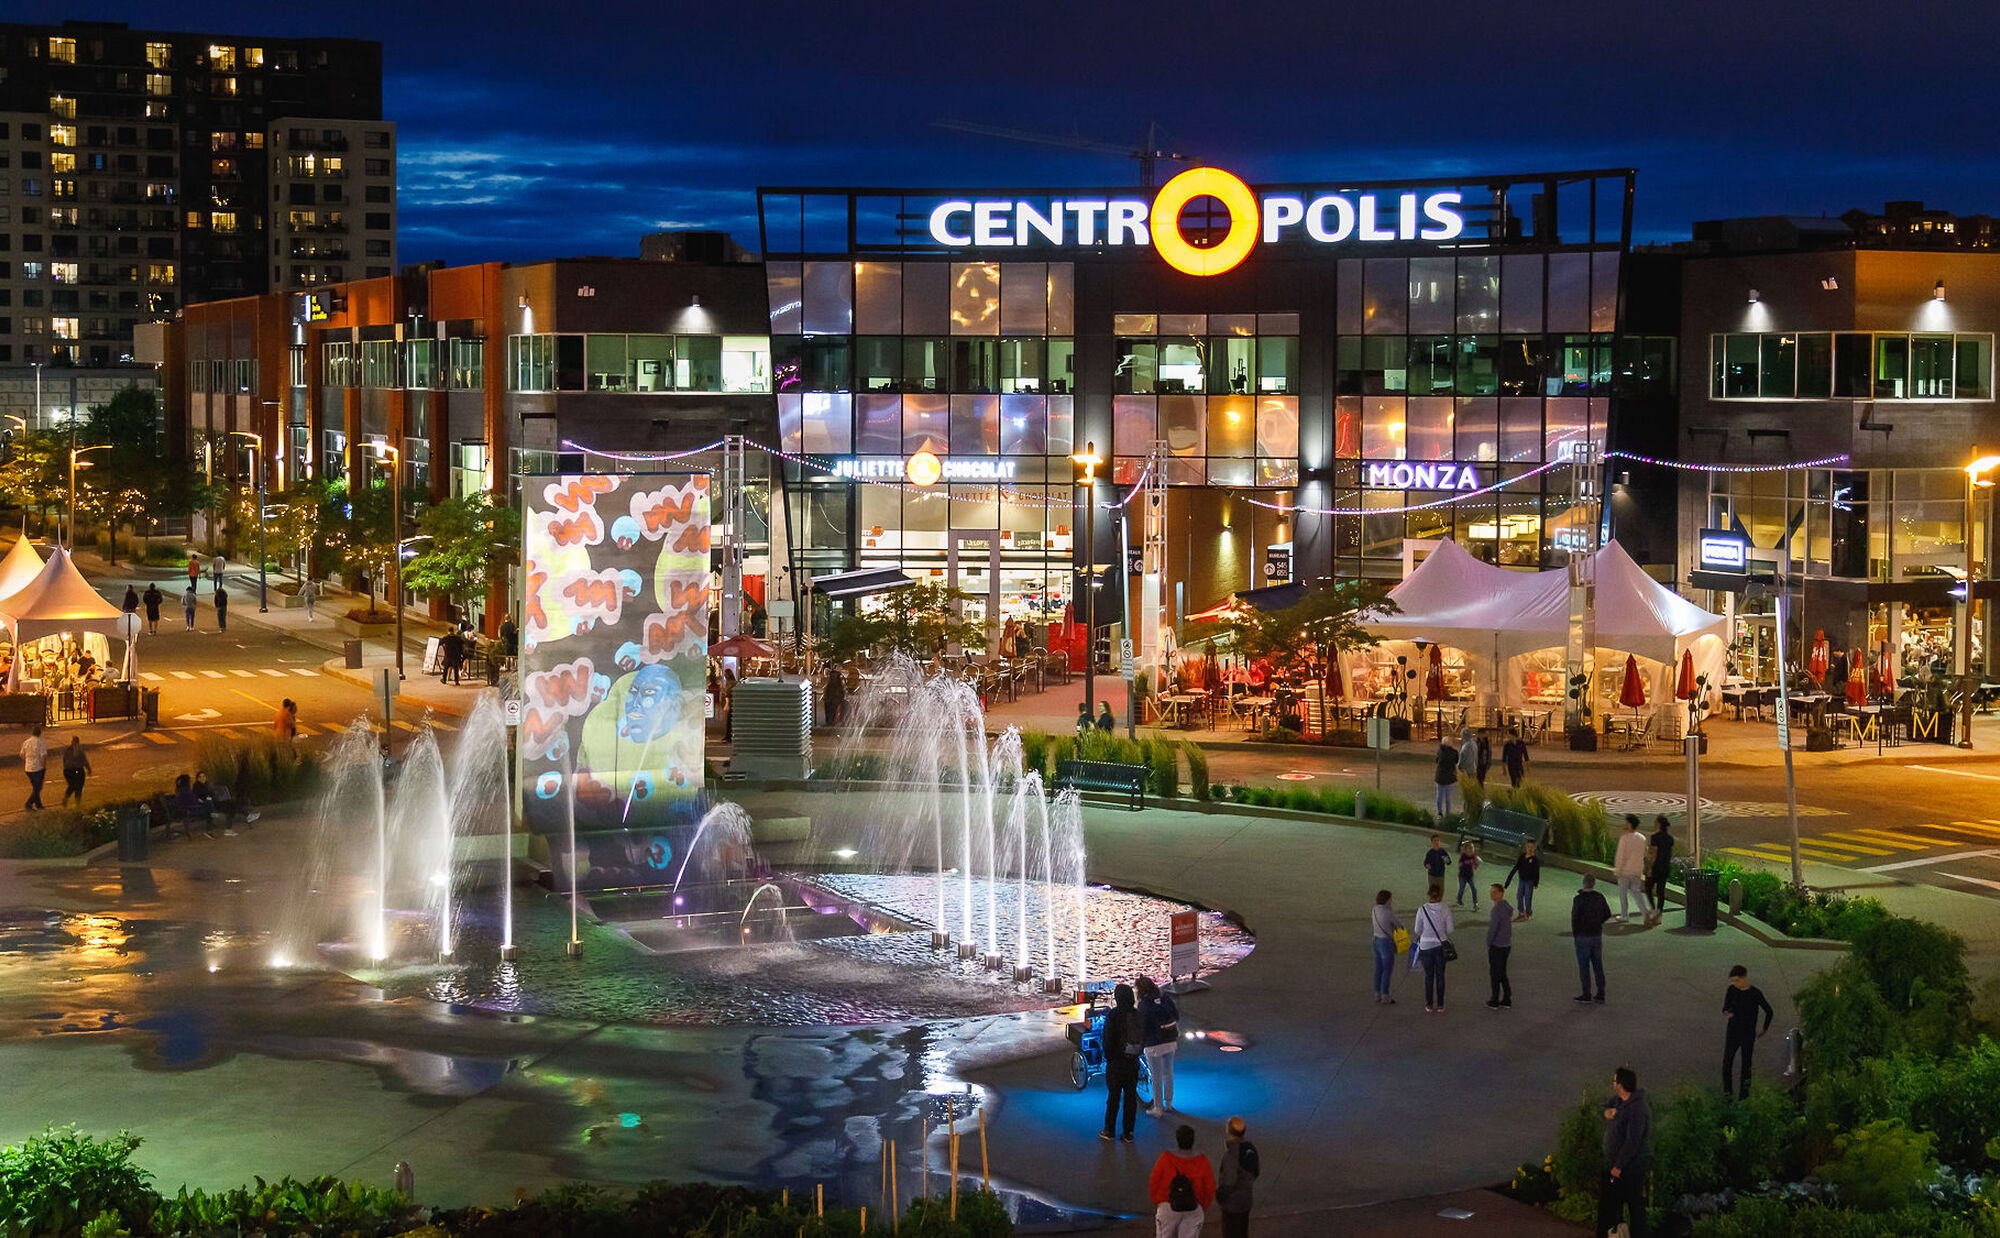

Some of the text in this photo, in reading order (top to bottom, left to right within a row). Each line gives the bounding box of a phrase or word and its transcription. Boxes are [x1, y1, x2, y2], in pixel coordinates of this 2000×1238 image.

[928, 166, 1465, 277] CENTROPOLIS
[831, 460, 905, 478] JULIETTE
[941, 461, 1016, 478] CHOCOLAT
[1368, 462, 1480, 490] MONZA
[1912, 711, 1939, 739] M
